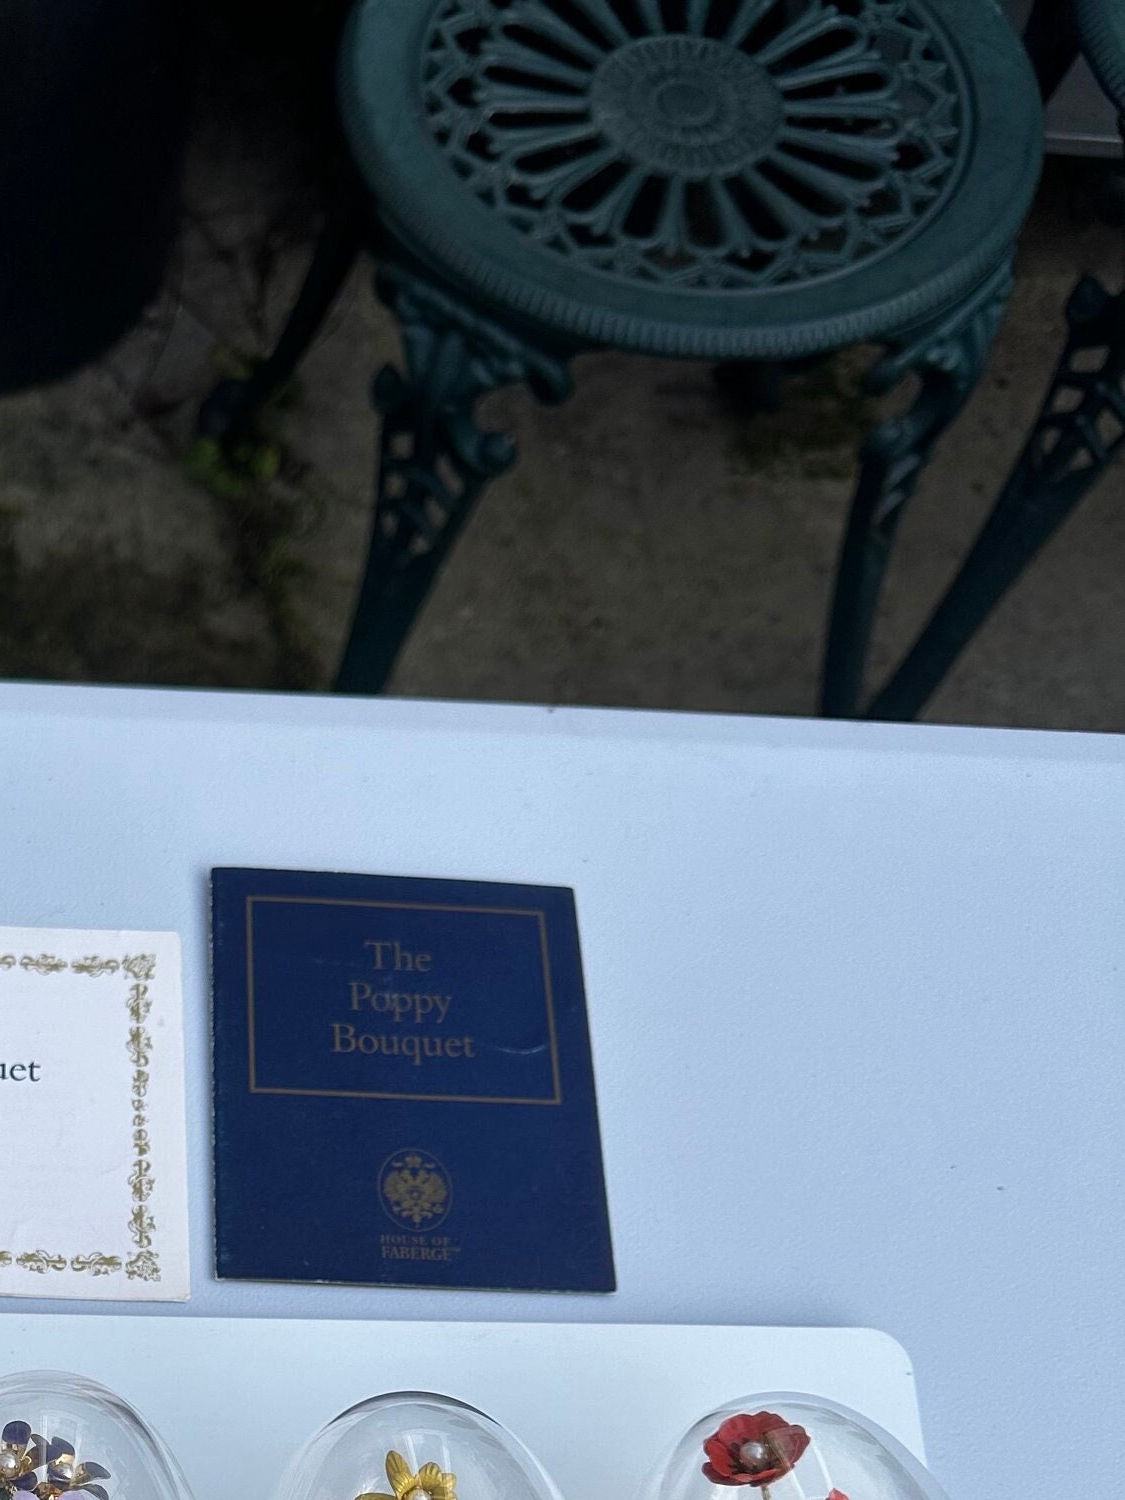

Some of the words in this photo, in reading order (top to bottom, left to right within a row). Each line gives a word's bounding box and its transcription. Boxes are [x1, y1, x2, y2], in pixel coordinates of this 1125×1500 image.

[364, 940, 432, 973] The
[348, 982, 453, 1023] Poppy
[331, 1024, 476, 1066] Bouquet
[379, 1233, 428, 1246] HOUSE
[431, 1236, 452, 1247] OF
